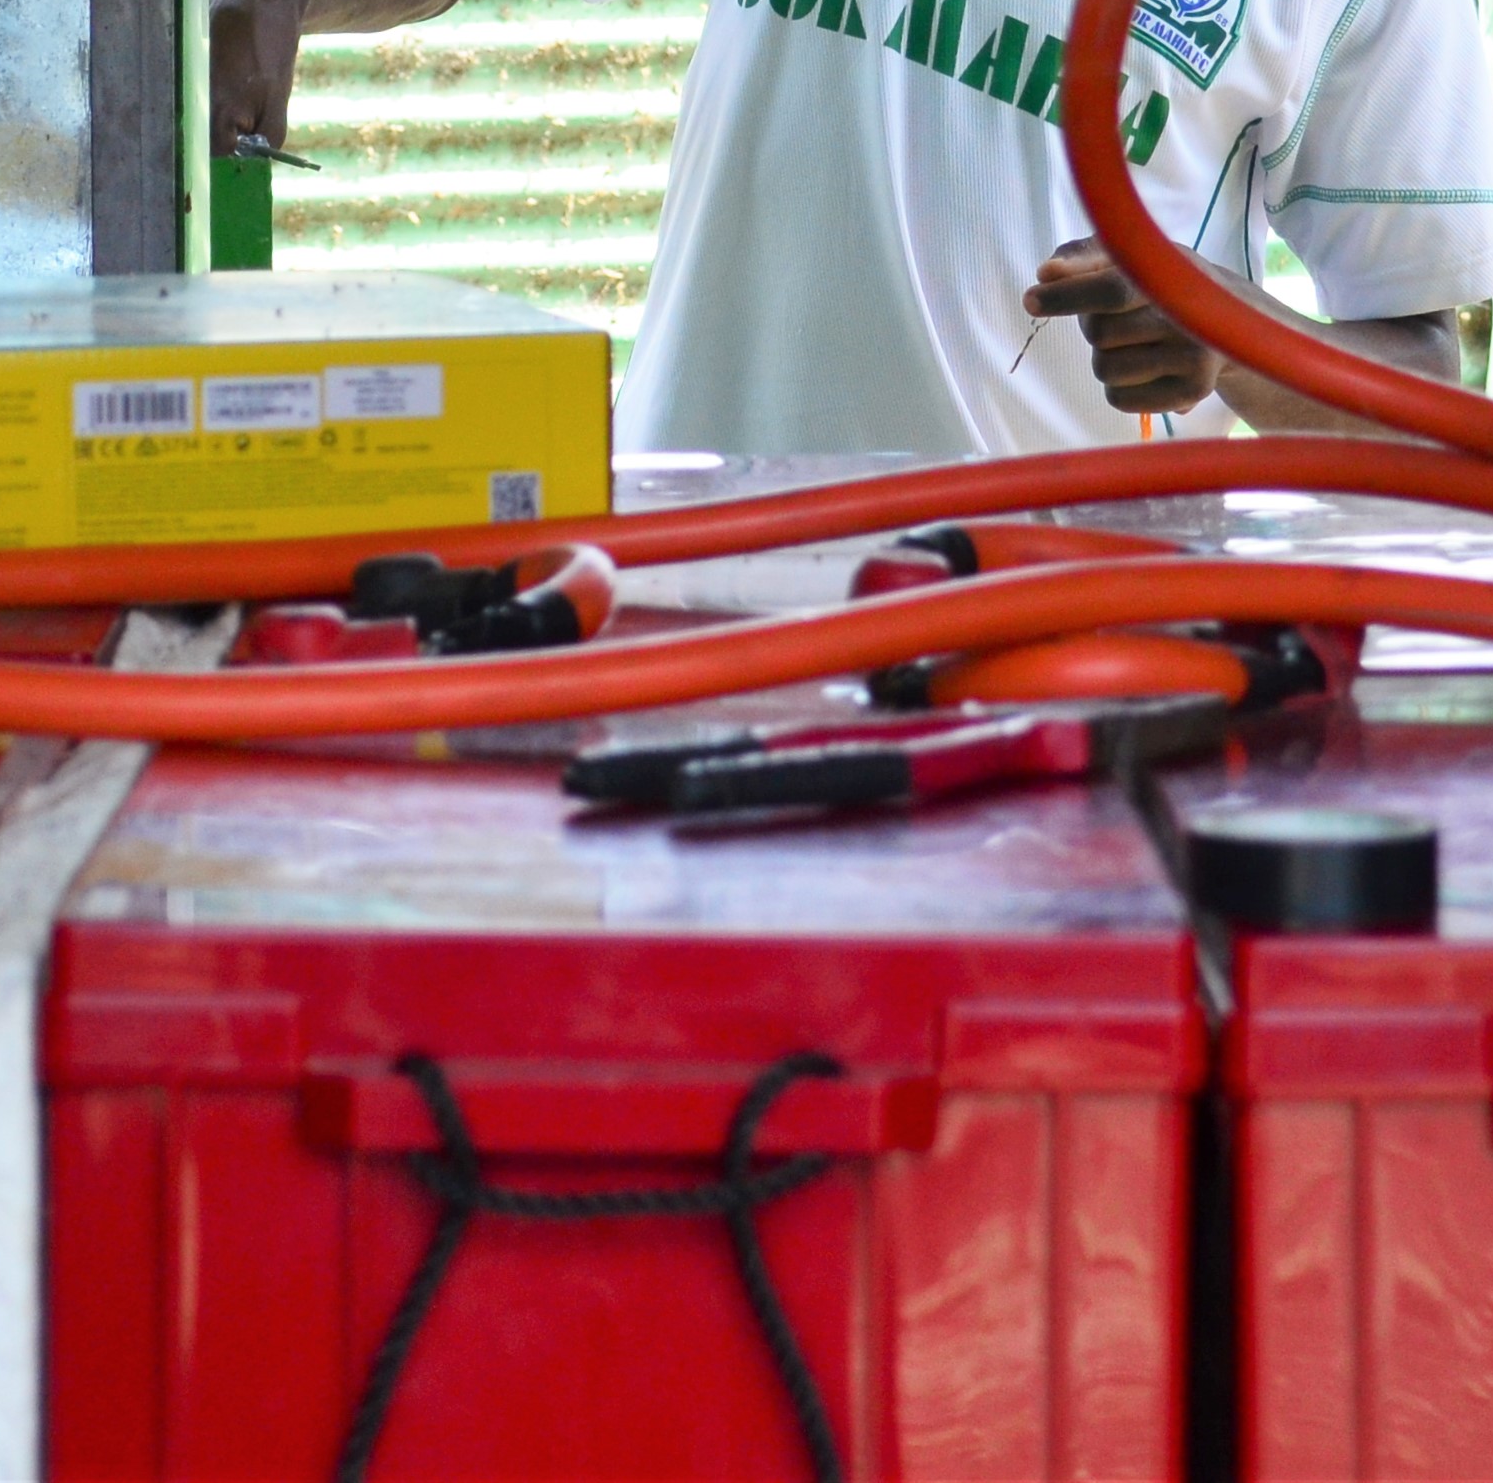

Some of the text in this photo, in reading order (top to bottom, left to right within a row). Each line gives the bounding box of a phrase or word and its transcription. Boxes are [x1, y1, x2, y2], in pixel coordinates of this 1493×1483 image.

[1214, 12, 1229, 28] 68
[1149, 21, 1193, 60] MAHIA
[1191, 51, 1210, 74] FC
